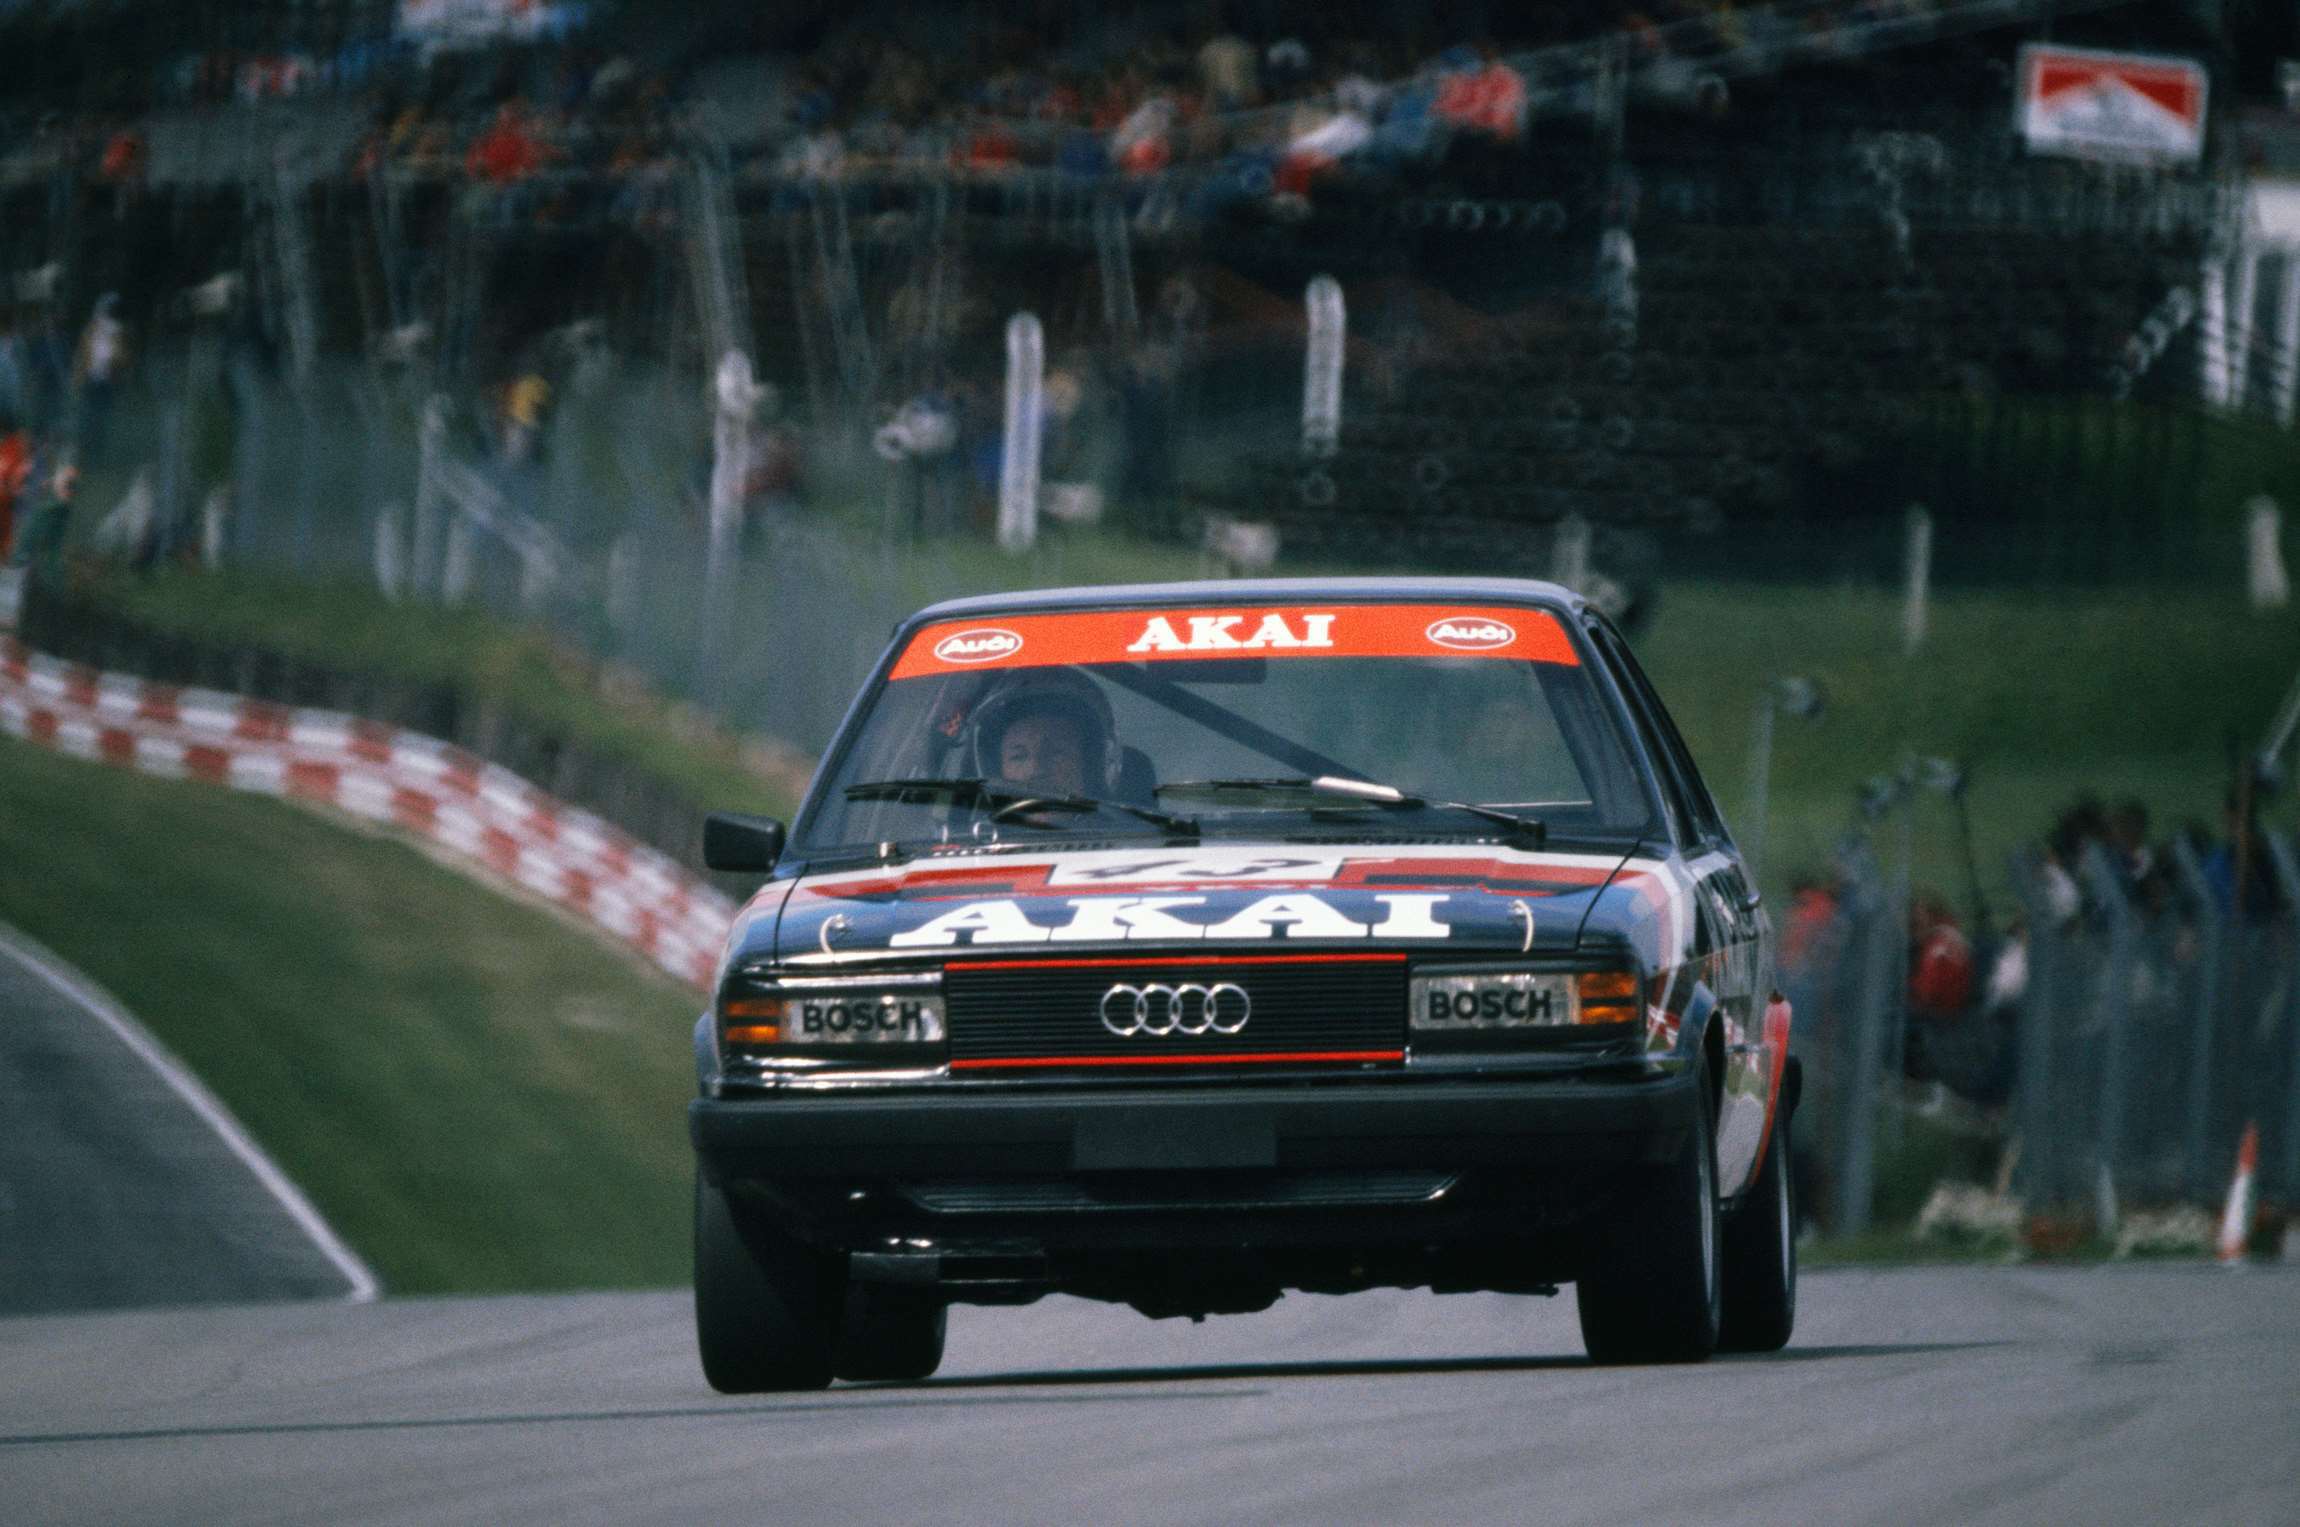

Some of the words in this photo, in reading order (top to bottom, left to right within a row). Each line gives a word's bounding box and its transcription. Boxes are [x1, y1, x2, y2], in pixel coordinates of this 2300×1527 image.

[939, 634, 1016, 656] Audi
[1126, 613, 1336, 652] AKAI
[1433, 623, 1508, 641] Audi
[889, 893, 1451, 947] AKAI
[802, 1001, 922, 1033] BOSCH
[1428, 989, 1552, 1020] BOSCH
